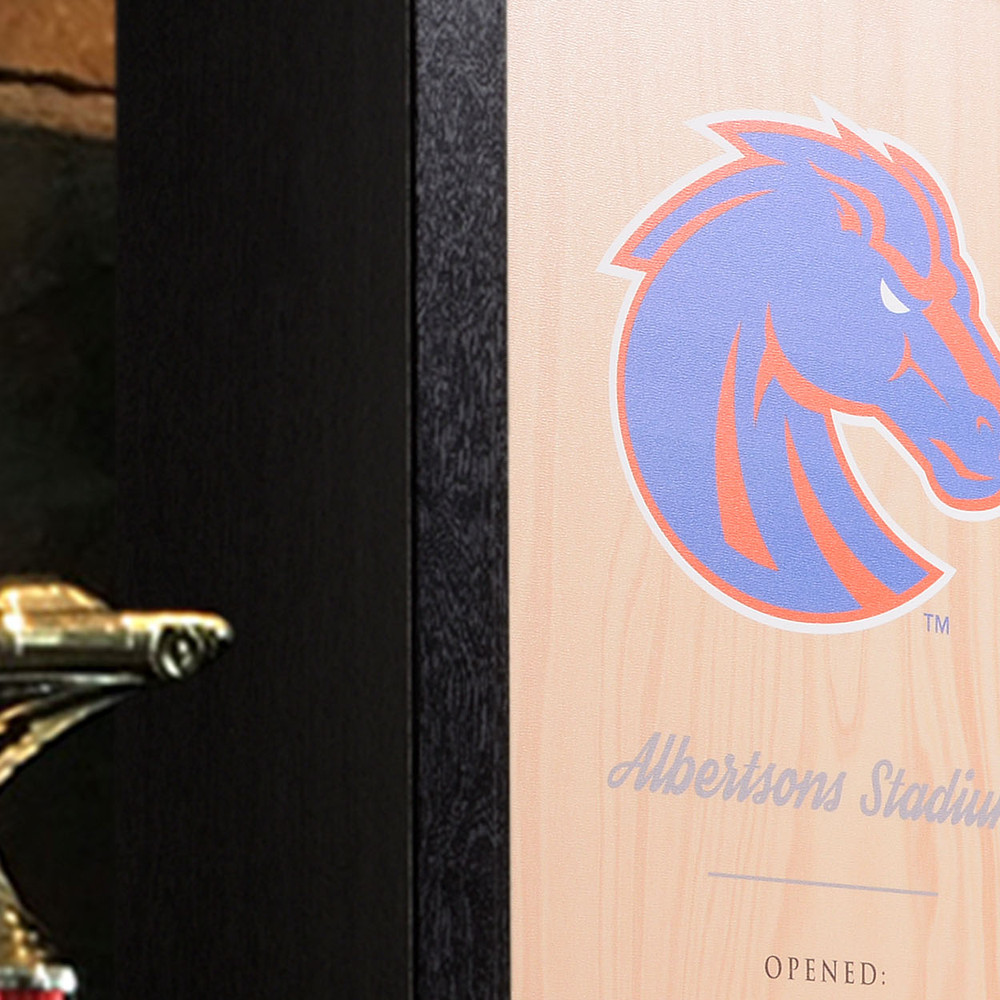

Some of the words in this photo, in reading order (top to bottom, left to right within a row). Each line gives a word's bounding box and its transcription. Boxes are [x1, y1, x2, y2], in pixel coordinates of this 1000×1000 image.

[924, 613, 950, 634] TM
[607, 731, 847, 812] Albertsons
[764, 955, 886, 985] OPENED:
